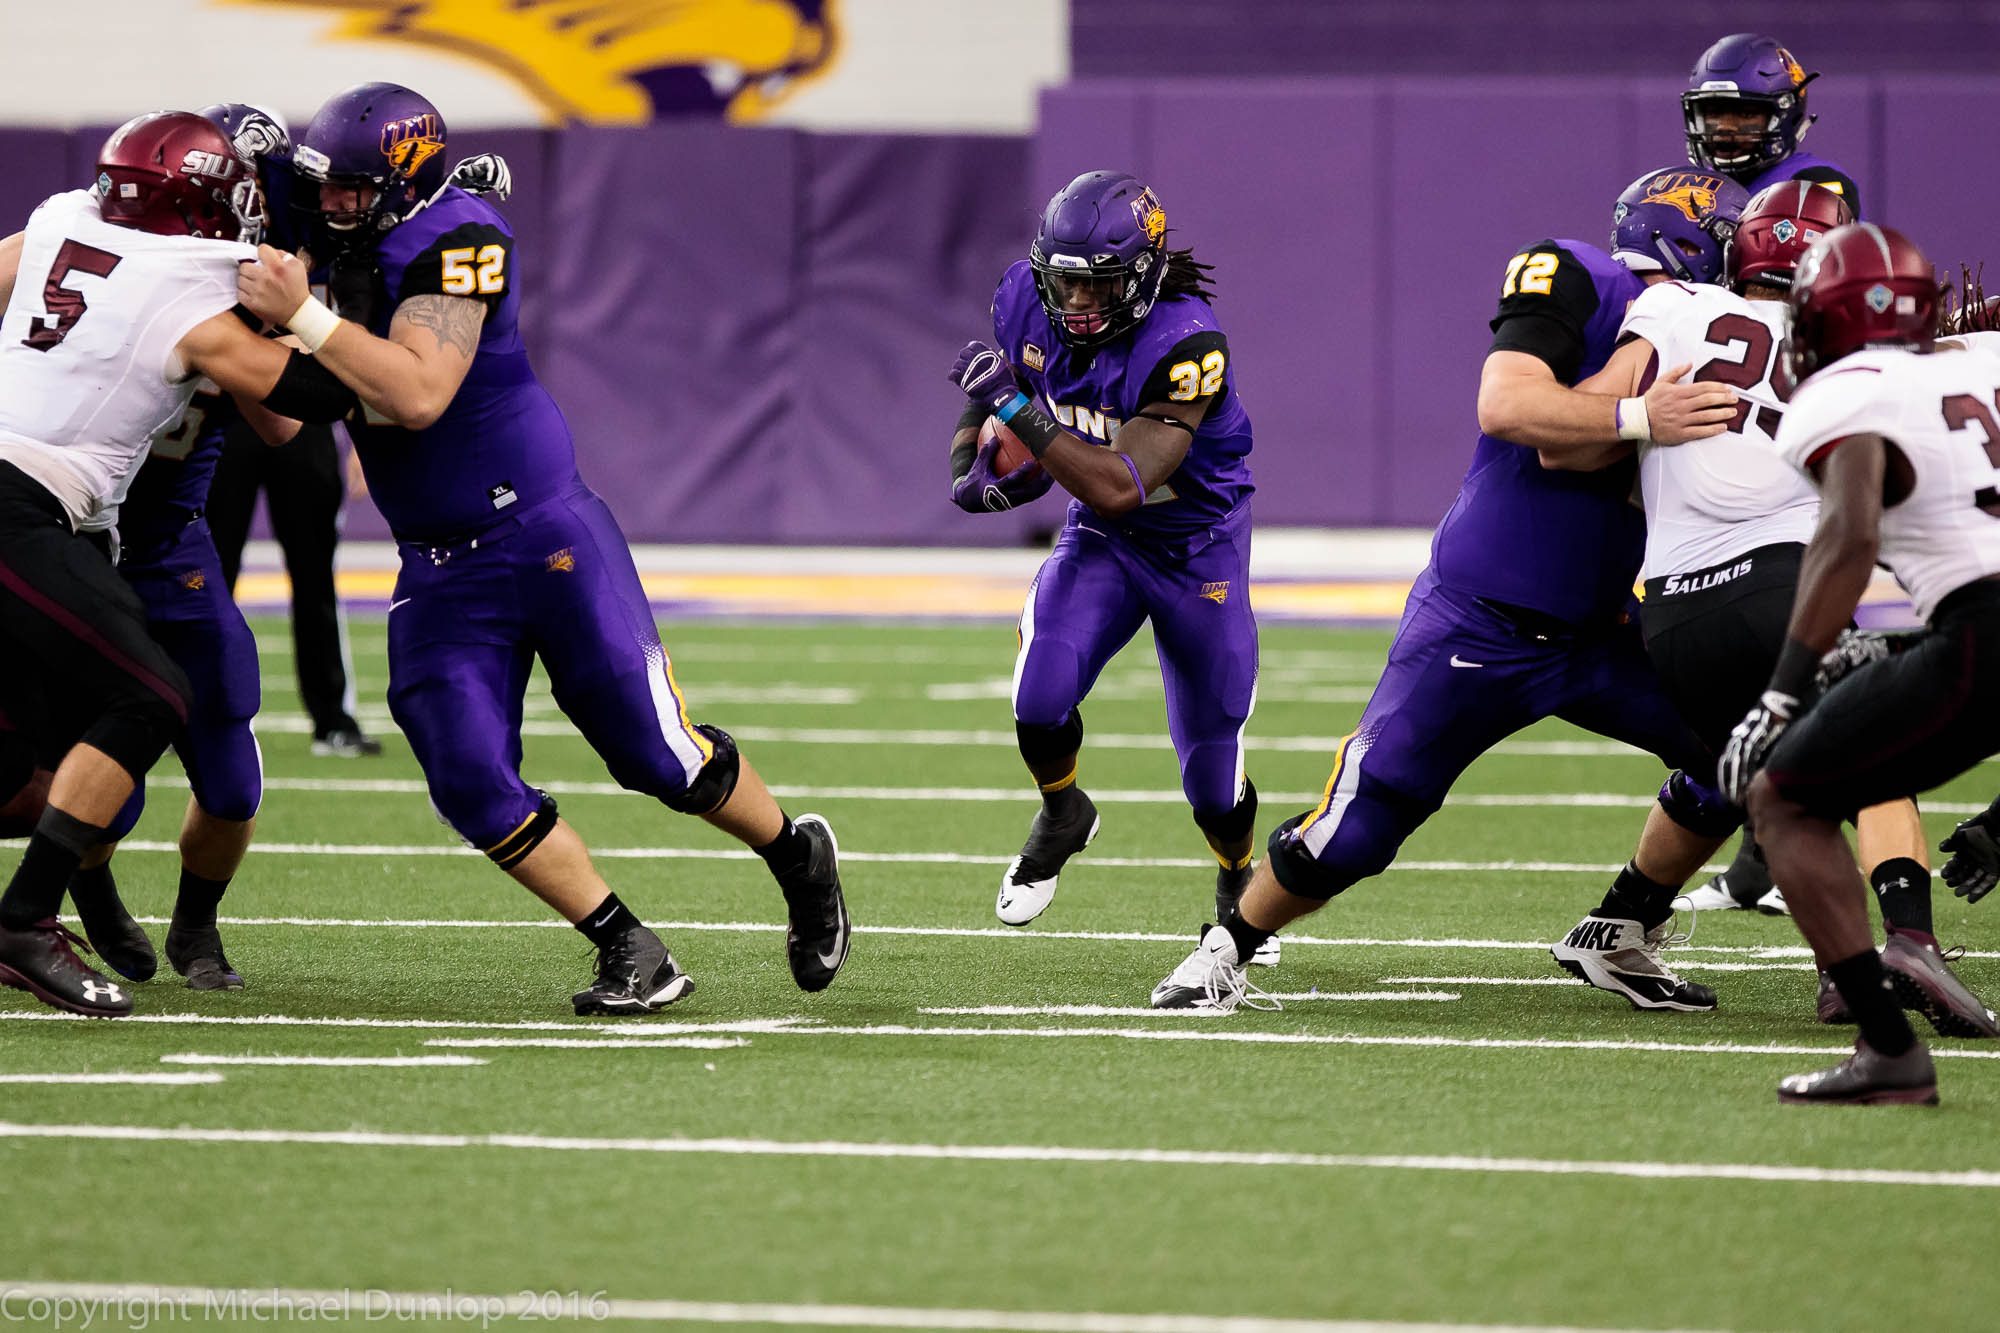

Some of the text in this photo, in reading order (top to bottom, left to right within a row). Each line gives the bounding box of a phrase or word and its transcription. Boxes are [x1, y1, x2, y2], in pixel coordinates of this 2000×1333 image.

[381, 114, 437, 156] UNI
[180, 149, 234, 180] SIU
[1646, 174, 1724, 197] UNI
[441, 244, 506, 296] 52
[1503, 252, 1560, 299] 72
[21, 238, 123, 352] 5
[1168, 350, 1225, 401] 32
[1046, 392, 1121, 441] UNI
[493, 486, 508, 497] XL
[1662, 558, 1753, 596] SALUKIS
[1564, 920, 1625, 951] NIKE
